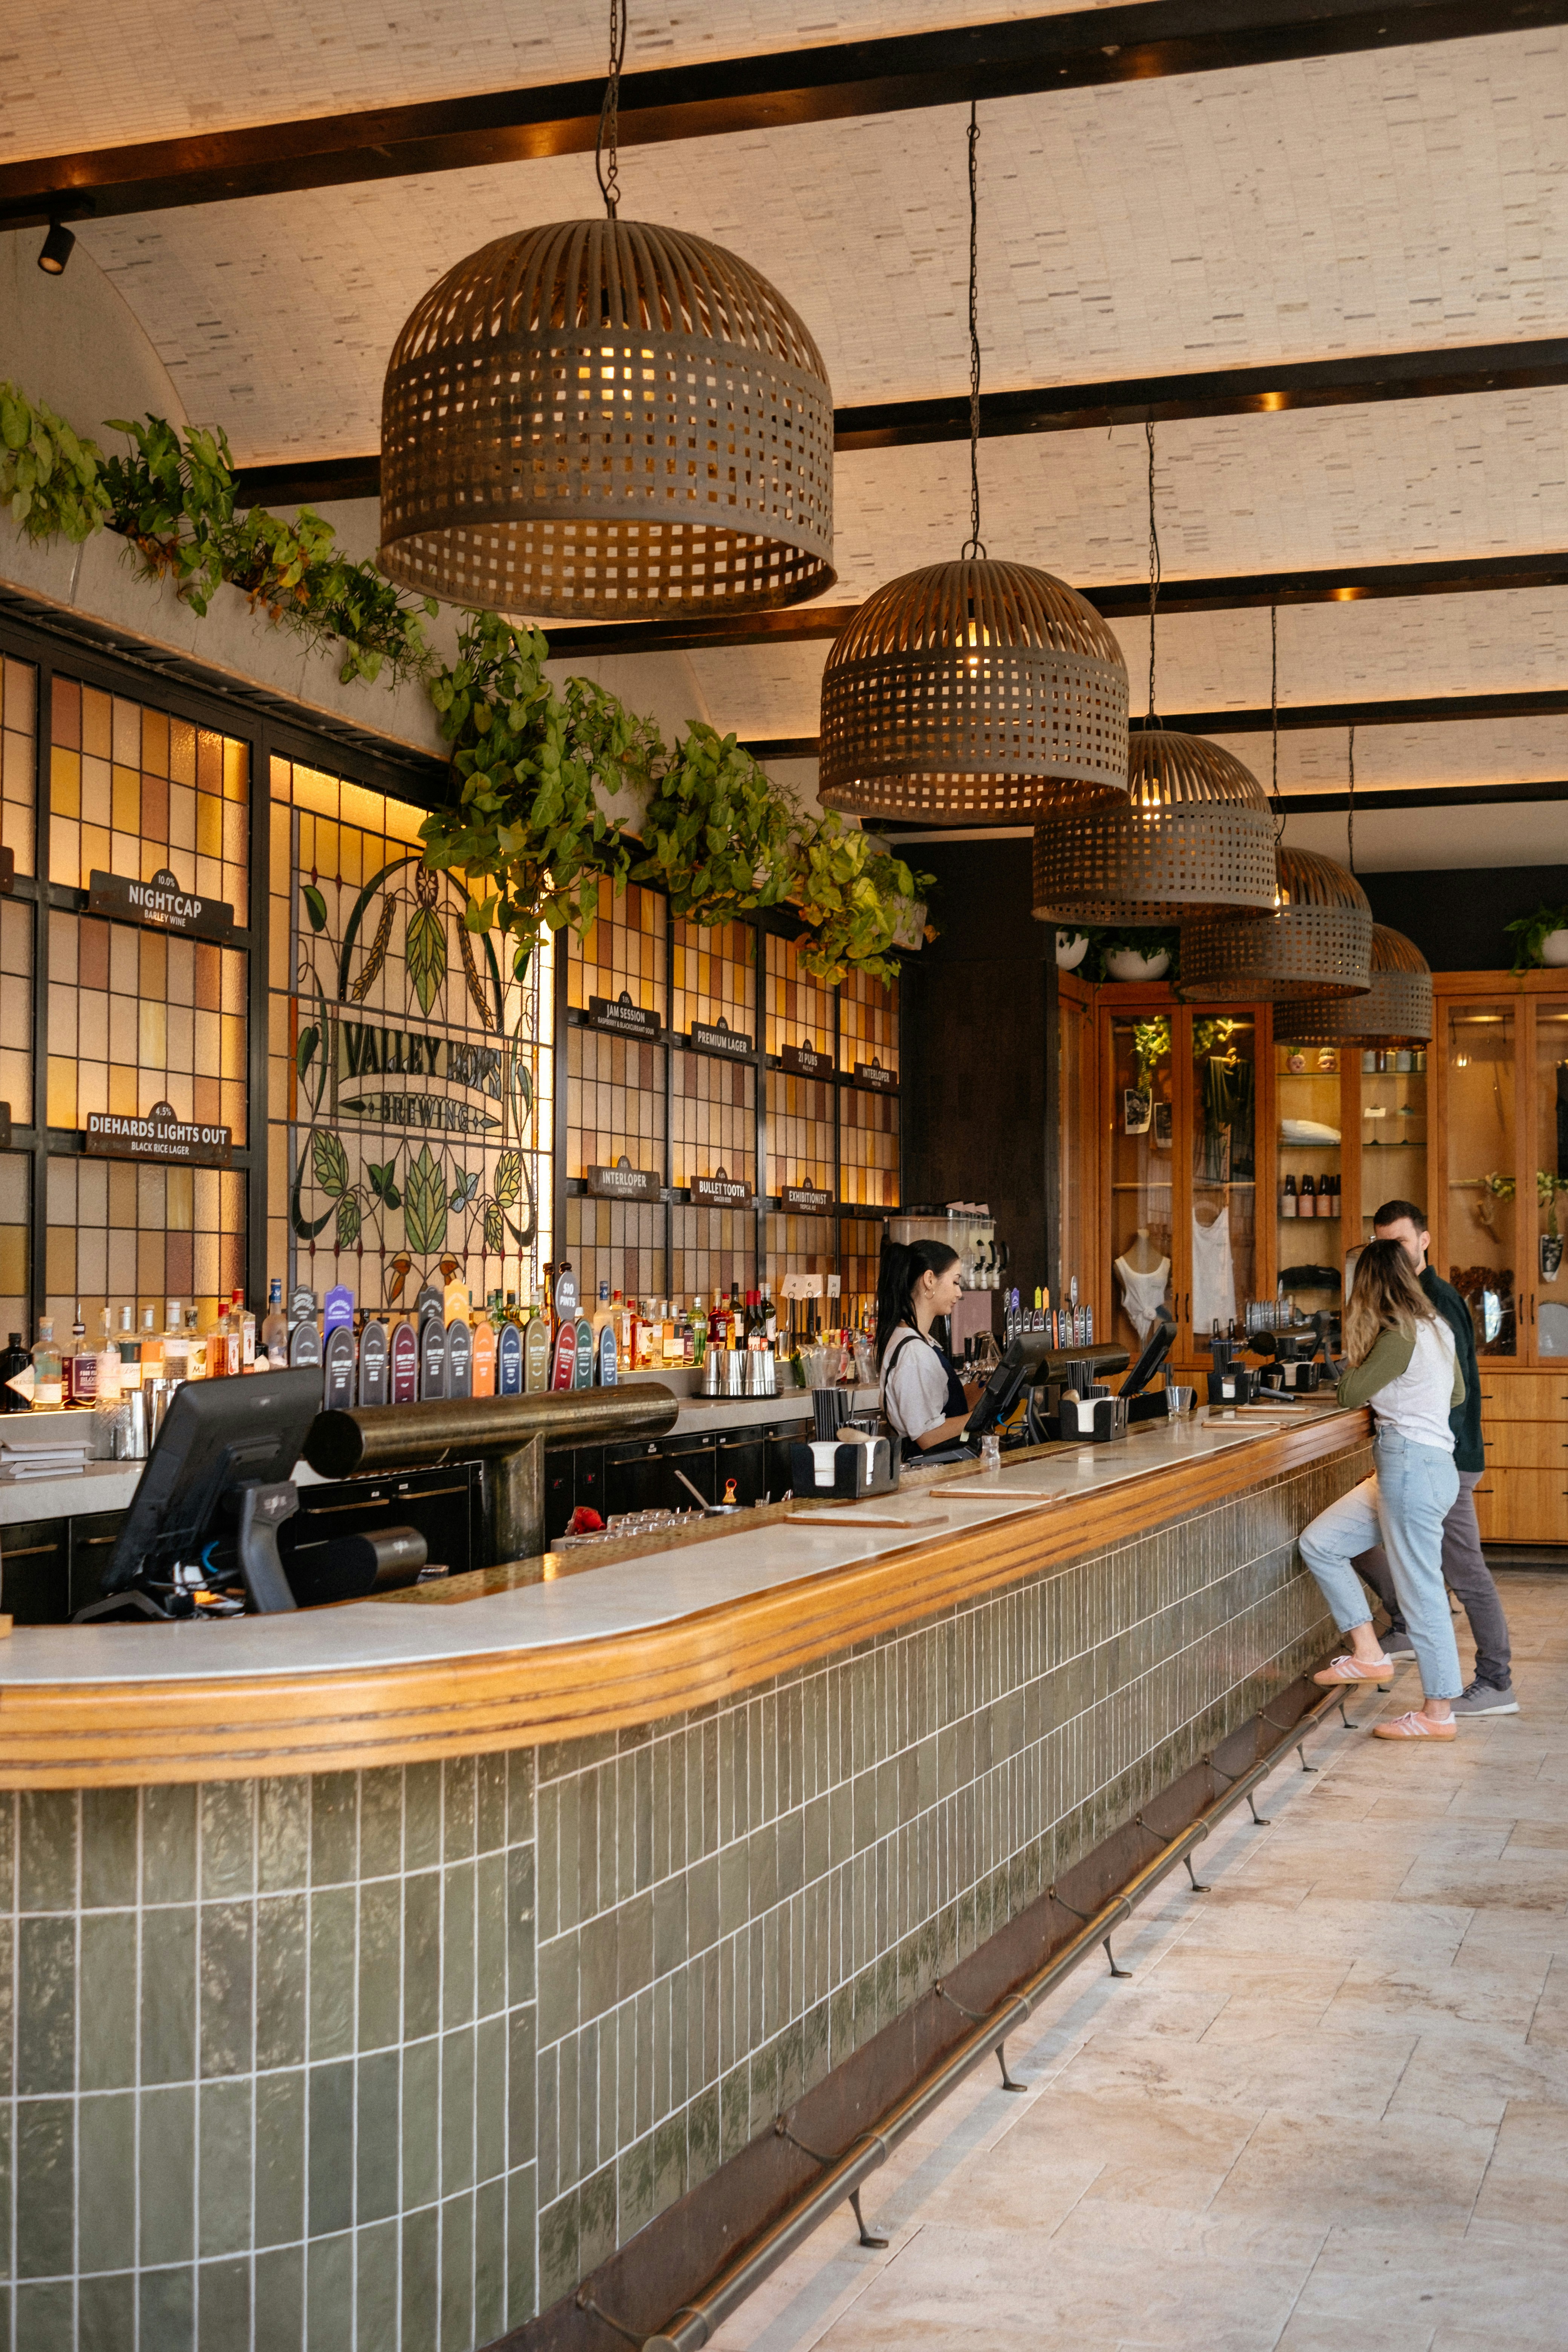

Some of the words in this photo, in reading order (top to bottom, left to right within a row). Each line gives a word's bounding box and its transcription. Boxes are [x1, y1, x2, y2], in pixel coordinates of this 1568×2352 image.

[158, 875, 175, 887] 10.0%
[129, 885, 202, 918] NIGHTCAP
[144, 909, 168, 922] BARLEY
[170, 916, 186, 927] WINE
[607, 1004, 619, 1018] JAM
[620, 1007, 645, 1023] SESSION
[598, 1017, 617, 1026] RASPBERRY
[620, 1021, 645, 1034] BLACKCURRANT
[343, 1021, 442, 1077] VALLEY
[698, 1030, 727, 1049] PREMIUM
[728, 1038, 747, 1053] LAGER
[798, 1051, 803, 1063] 21
[804, 1053, 818, 1066] PUBS
[863, 1067, 890, 1083] INTERLOPER
[156, 1107, 171, 1116] 4.5%
[382, 1095, 469, 1133] BREWING
[90, 1116, 155, 1138] DIEHARDS
[158, 1123, 199, 1142] LIGHTS
[202, 1128, 227, 1145] OUT
[132, 1142, 152, 1152] BLACK
[153, 1144, 168, 1153] RICE
[169, 1145, 189, 1155] LAGER
[603, 1171, 646, 1188] INTERLOPER
[699, 1181, 722, 1195] BULLET
[723, 1184, 745, 1197] TOOTH
[789, 1190, 827, 1205] EXHIBITIONIST
[563, 1282, 574, 1295] $10
[559, 1295, 576, 1308] PINTS
